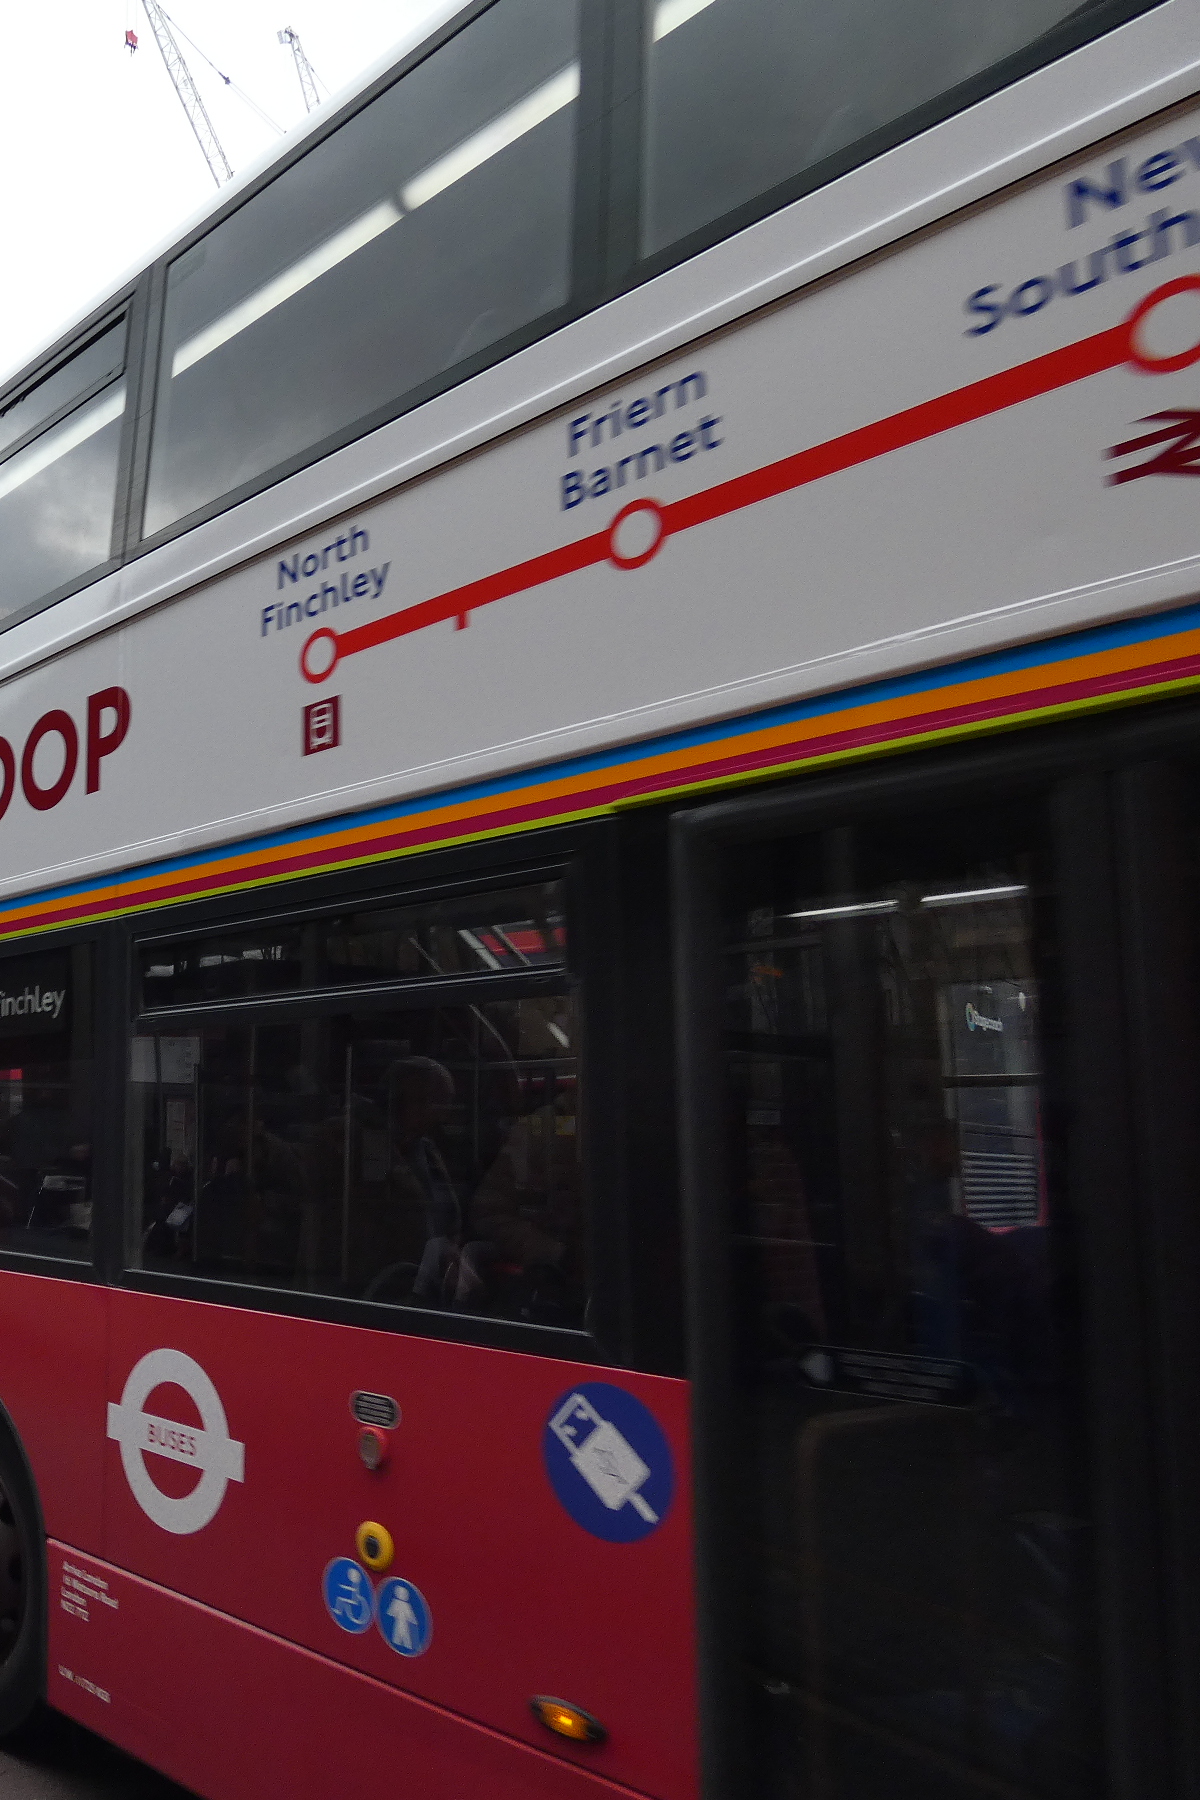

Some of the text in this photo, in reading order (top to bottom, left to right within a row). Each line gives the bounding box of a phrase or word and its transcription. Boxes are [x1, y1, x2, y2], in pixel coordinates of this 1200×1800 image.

[566, 369, 708, 459] Friern
[560, 411, 723, 511] Barnet
[276, 525, 370, 590] North
[261, 560, 389, 636] Finchley
[146, 1422, 197, 1458] BUSES
